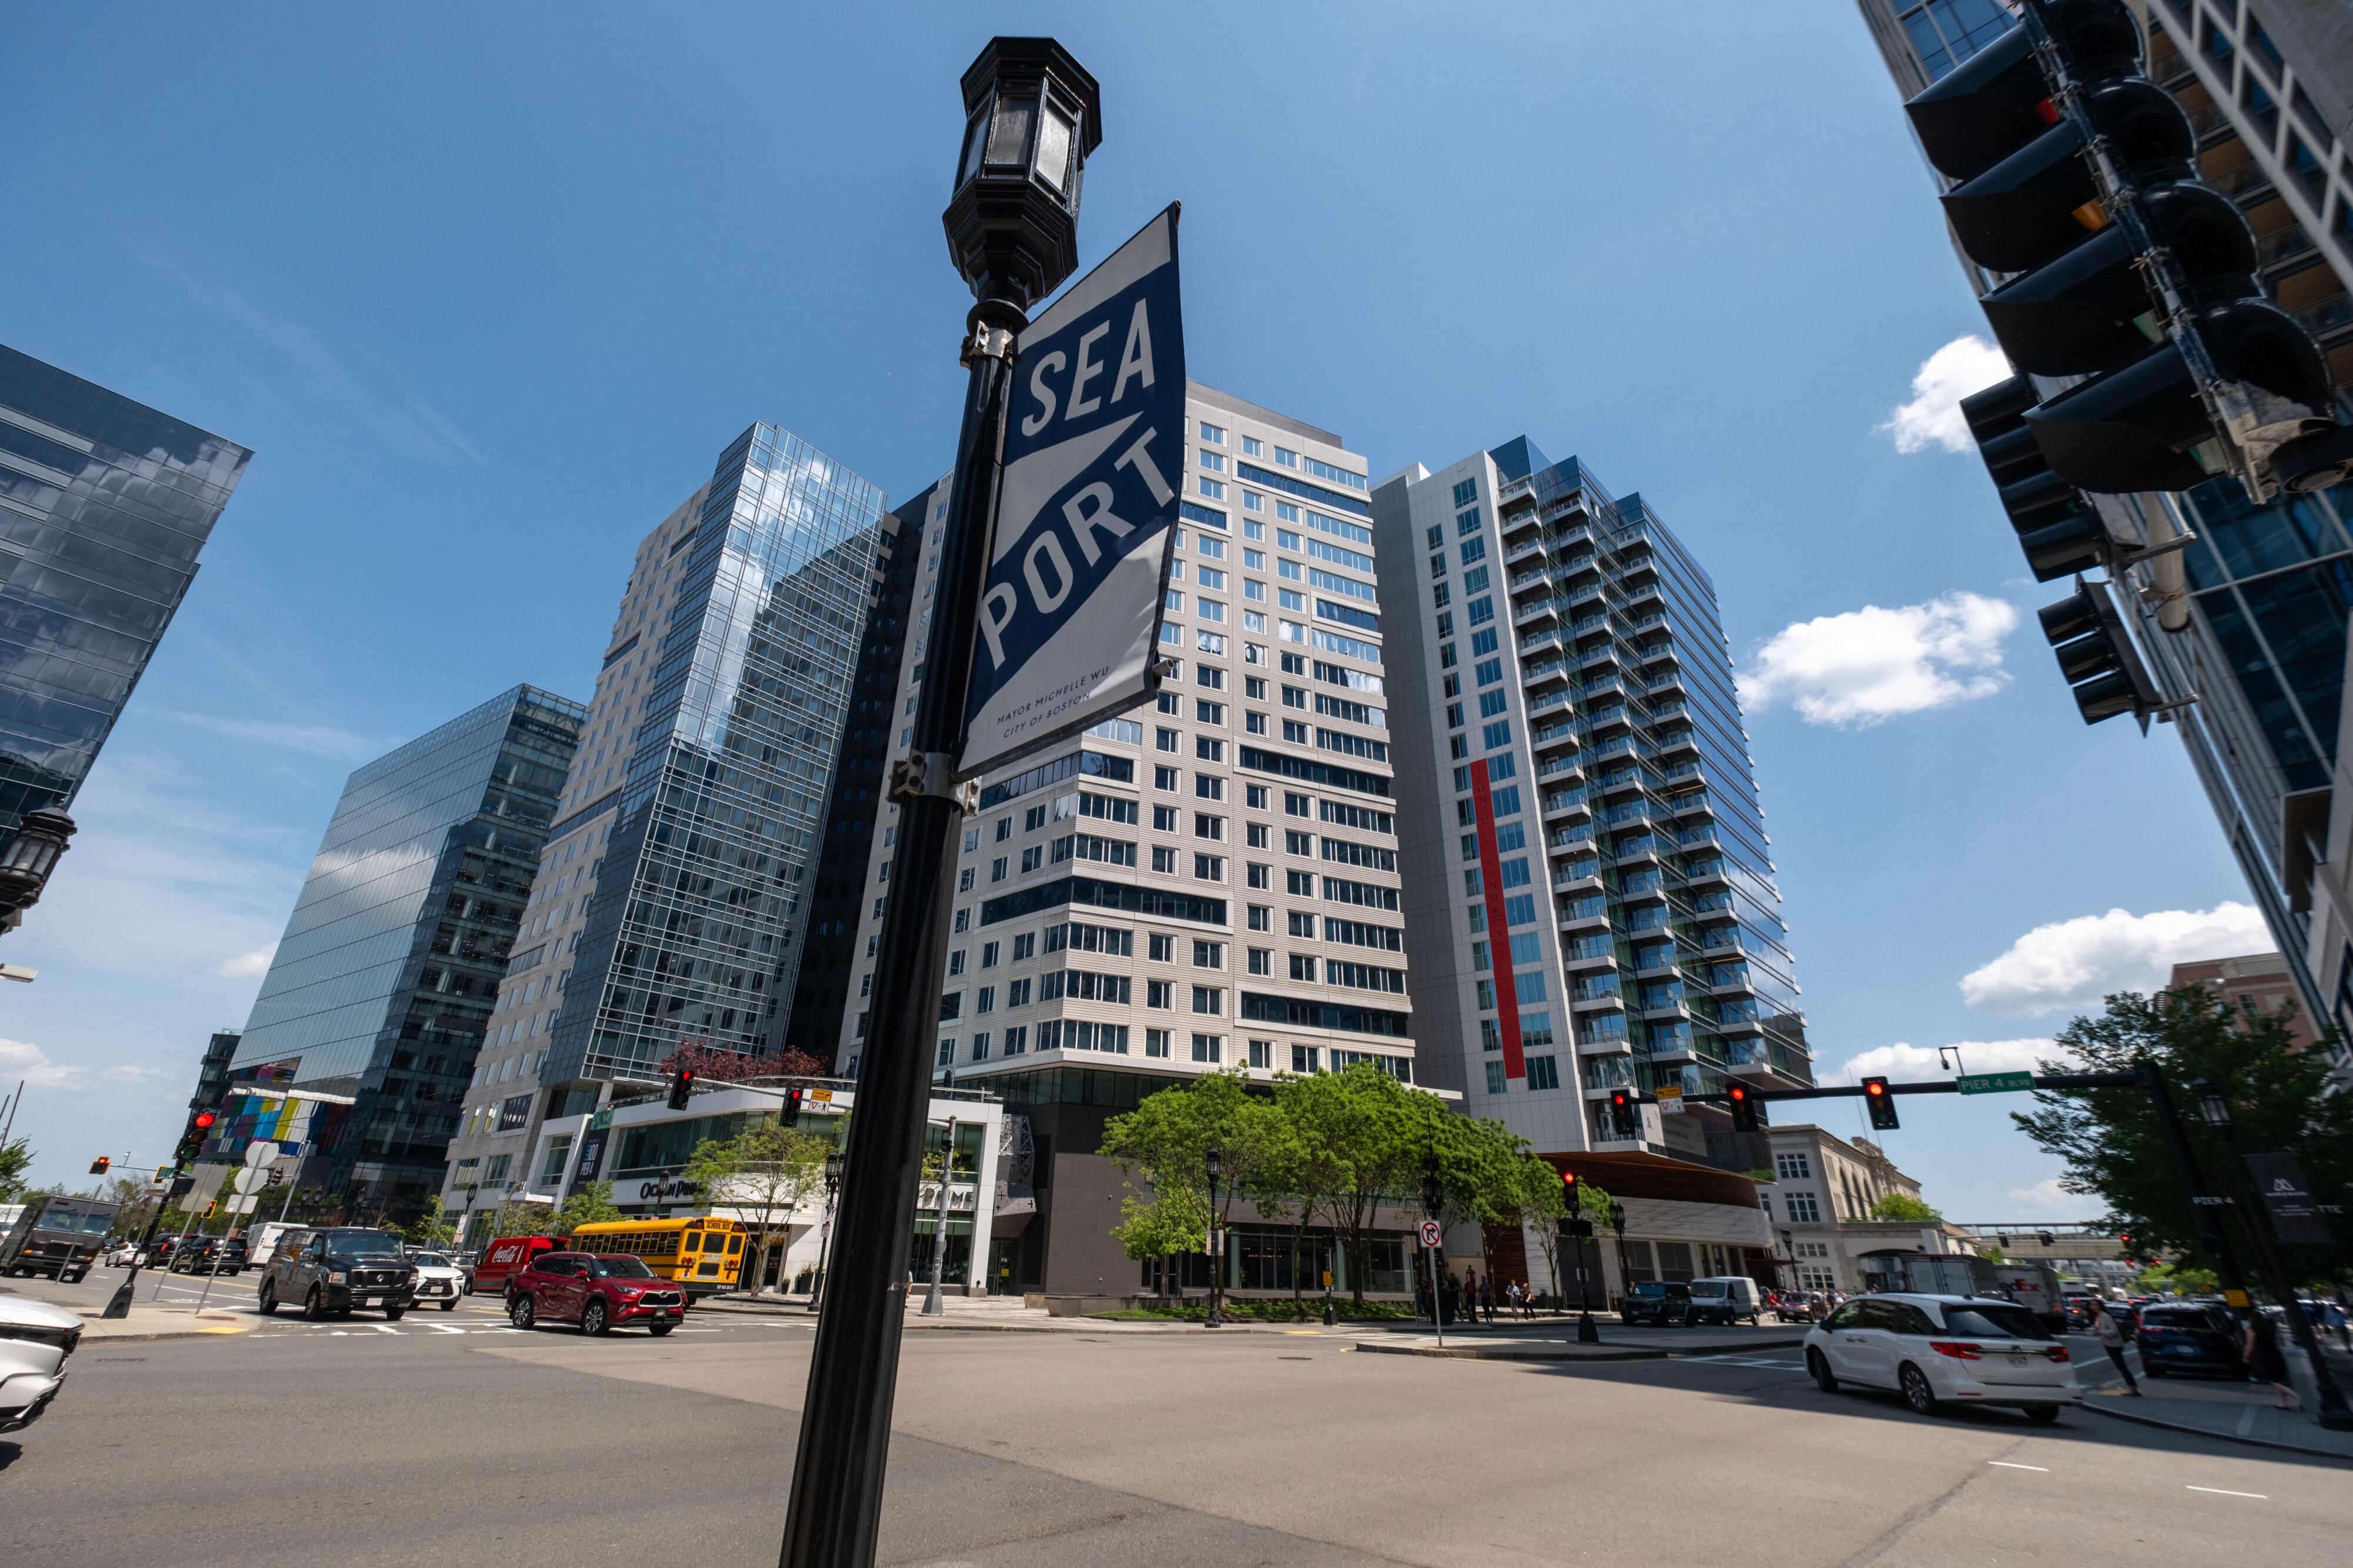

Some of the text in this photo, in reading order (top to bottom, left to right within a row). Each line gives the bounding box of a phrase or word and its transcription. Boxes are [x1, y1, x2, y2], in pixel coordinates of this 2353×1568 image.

[1022, 298, 1155, 436] SEA
[979, 426, 1175, 670] PORT
[997, 666, 1109, 725] MAYOR MICHELLE WU
[1004, 691, 1091, 738] CITY OF BOSTON
[1477, 766, 1488, 823] ICONIC
[1485, 837, 1498, 900] LIVING
[1961, 1077, 2031, 1091] PIER 4 BLVD
[588, 1143, 599, 1161] 100
[580, 1162, 594, 1176] PIER 4
[675, 1180, 706, 1198] PRIM
[2192, 1197, 2224, 1205] PIER
[2315, 1205, 2345, 1214] TTE
[706, 1222, 721, 1230] SCHOOL
[1999, 1279, 2039, 1292] edEx
